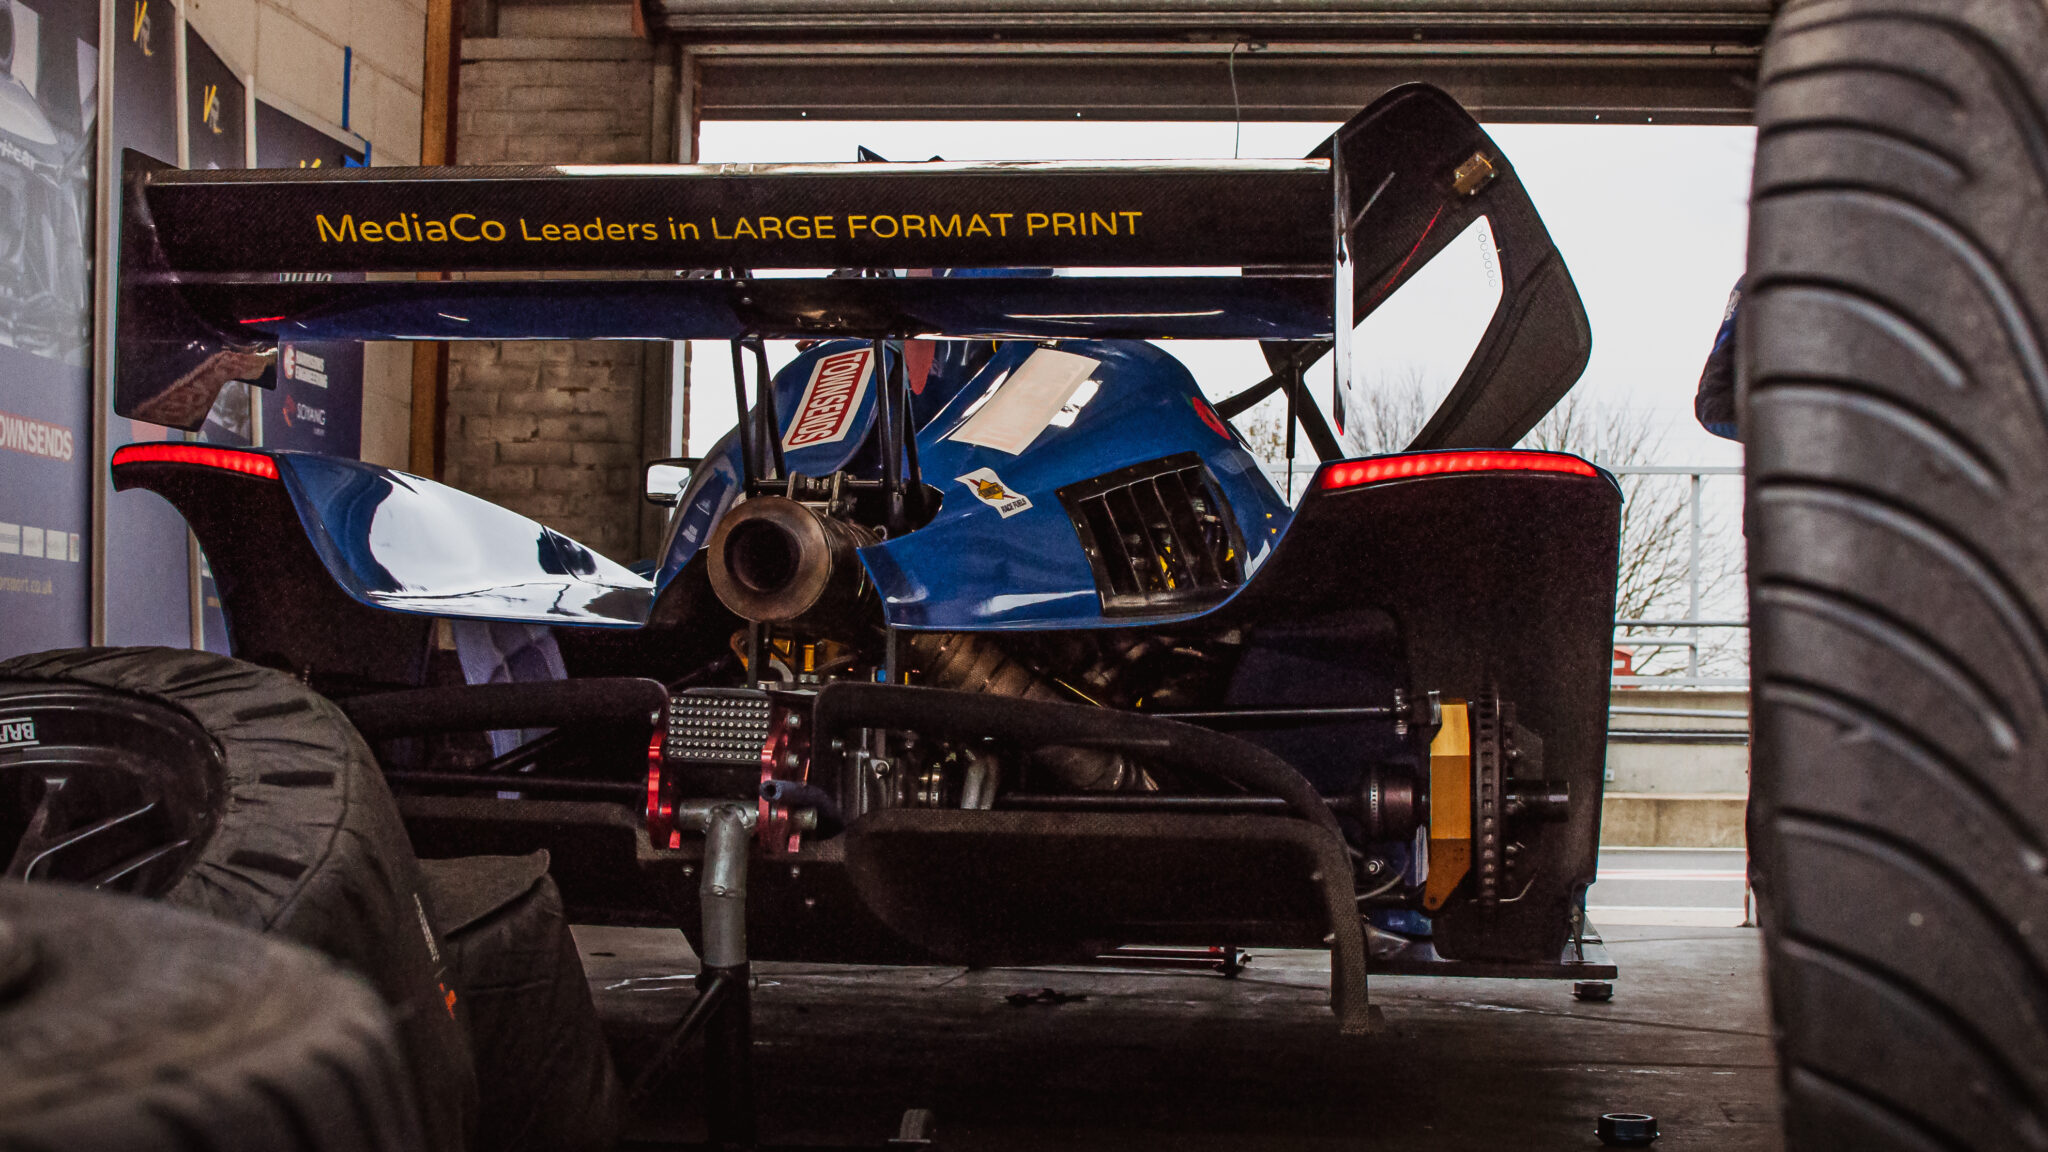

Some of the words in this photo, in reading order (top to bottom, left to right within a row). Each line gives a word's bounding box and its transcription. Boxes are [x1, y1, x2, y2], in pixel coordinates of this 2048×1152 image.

[315, 212, 507, 243] MediaCo
[519, 216, 659, 242] Leaders
[667, 216, 700, 241] in
[711, 215, 837, 240] LARGE
[847, 212, 1014, 239] FORMAT
[1025, 210, 1144, 237] PRINT
[790, 352, 864, 444] TOWNSENDS
[1000, 502, 1014, 514] RACE
[1013, 497, 1027, 509] FUELS
